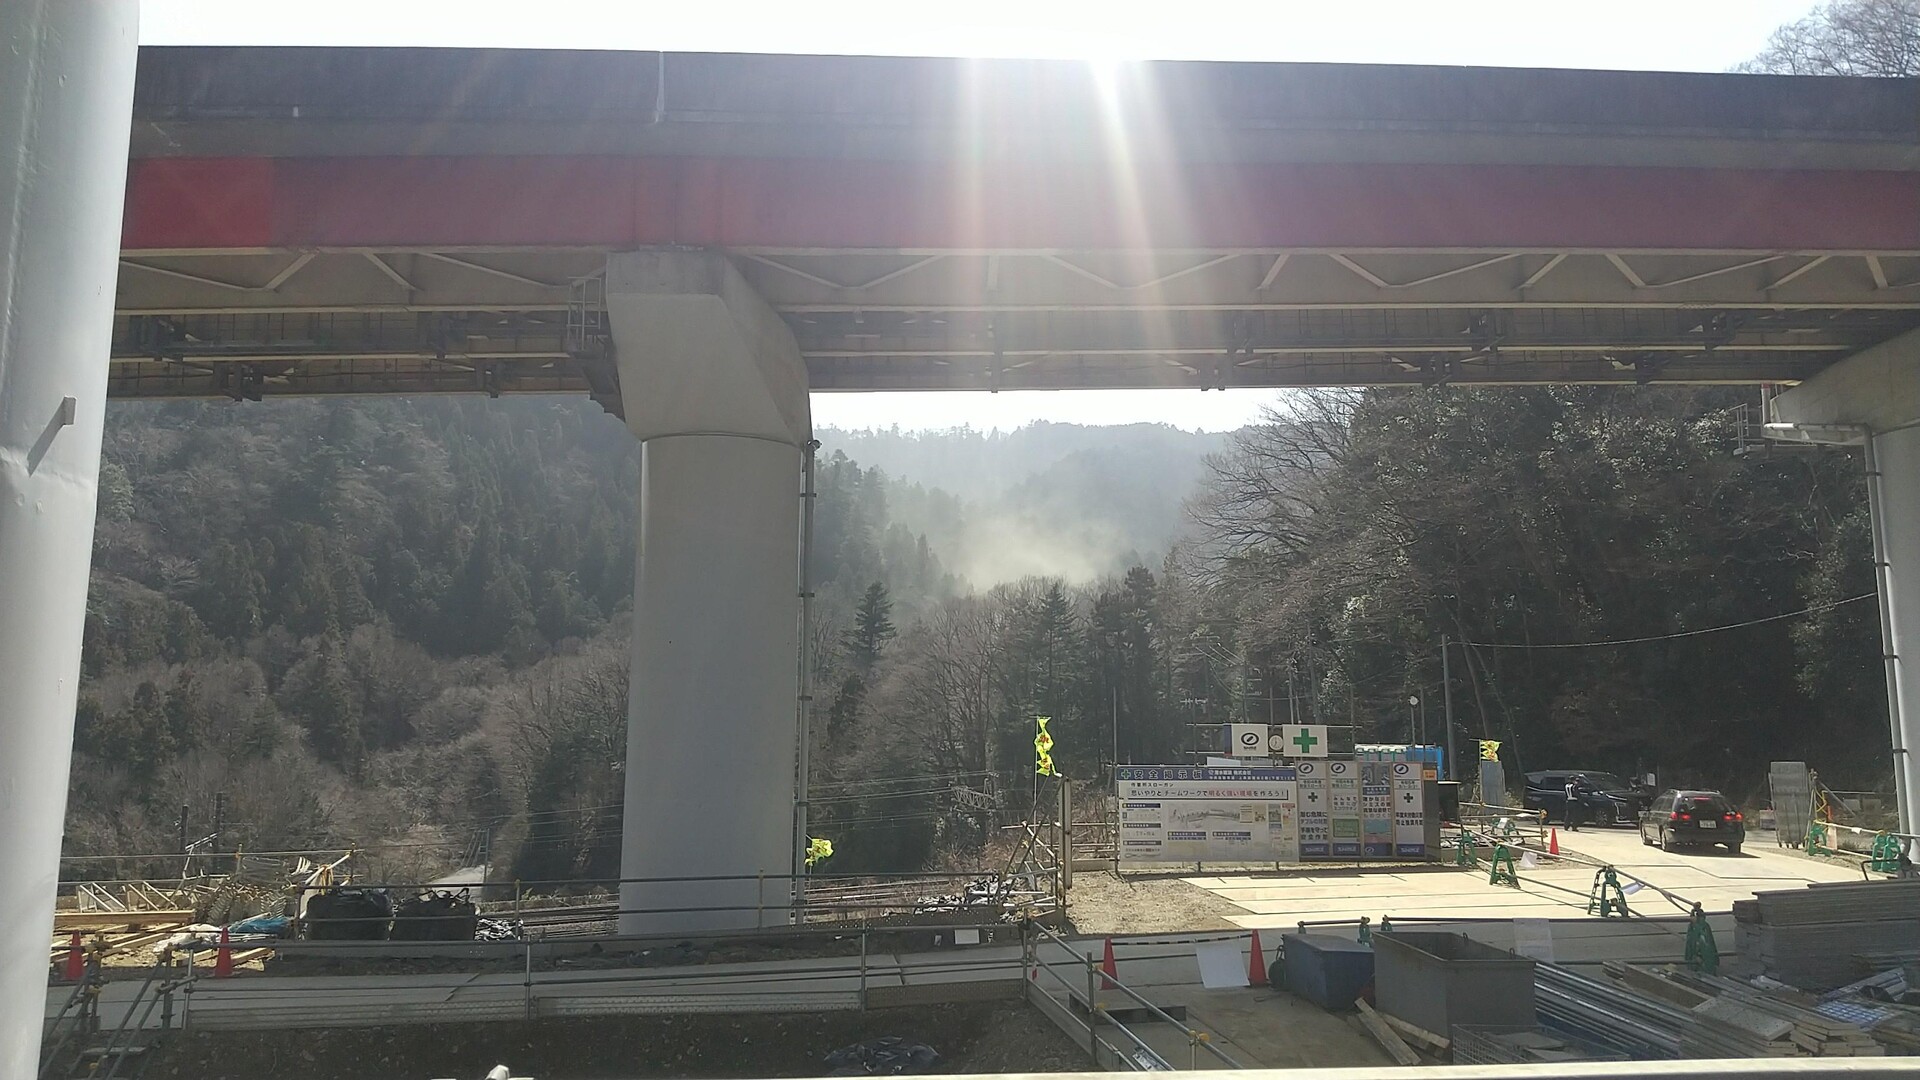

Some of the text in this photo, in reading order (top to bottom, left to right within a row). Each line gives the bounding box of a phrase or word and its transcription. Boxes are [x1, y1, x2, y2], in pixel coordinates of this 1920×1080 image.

[1133, 769, 1203, 780] 安全掲示板
